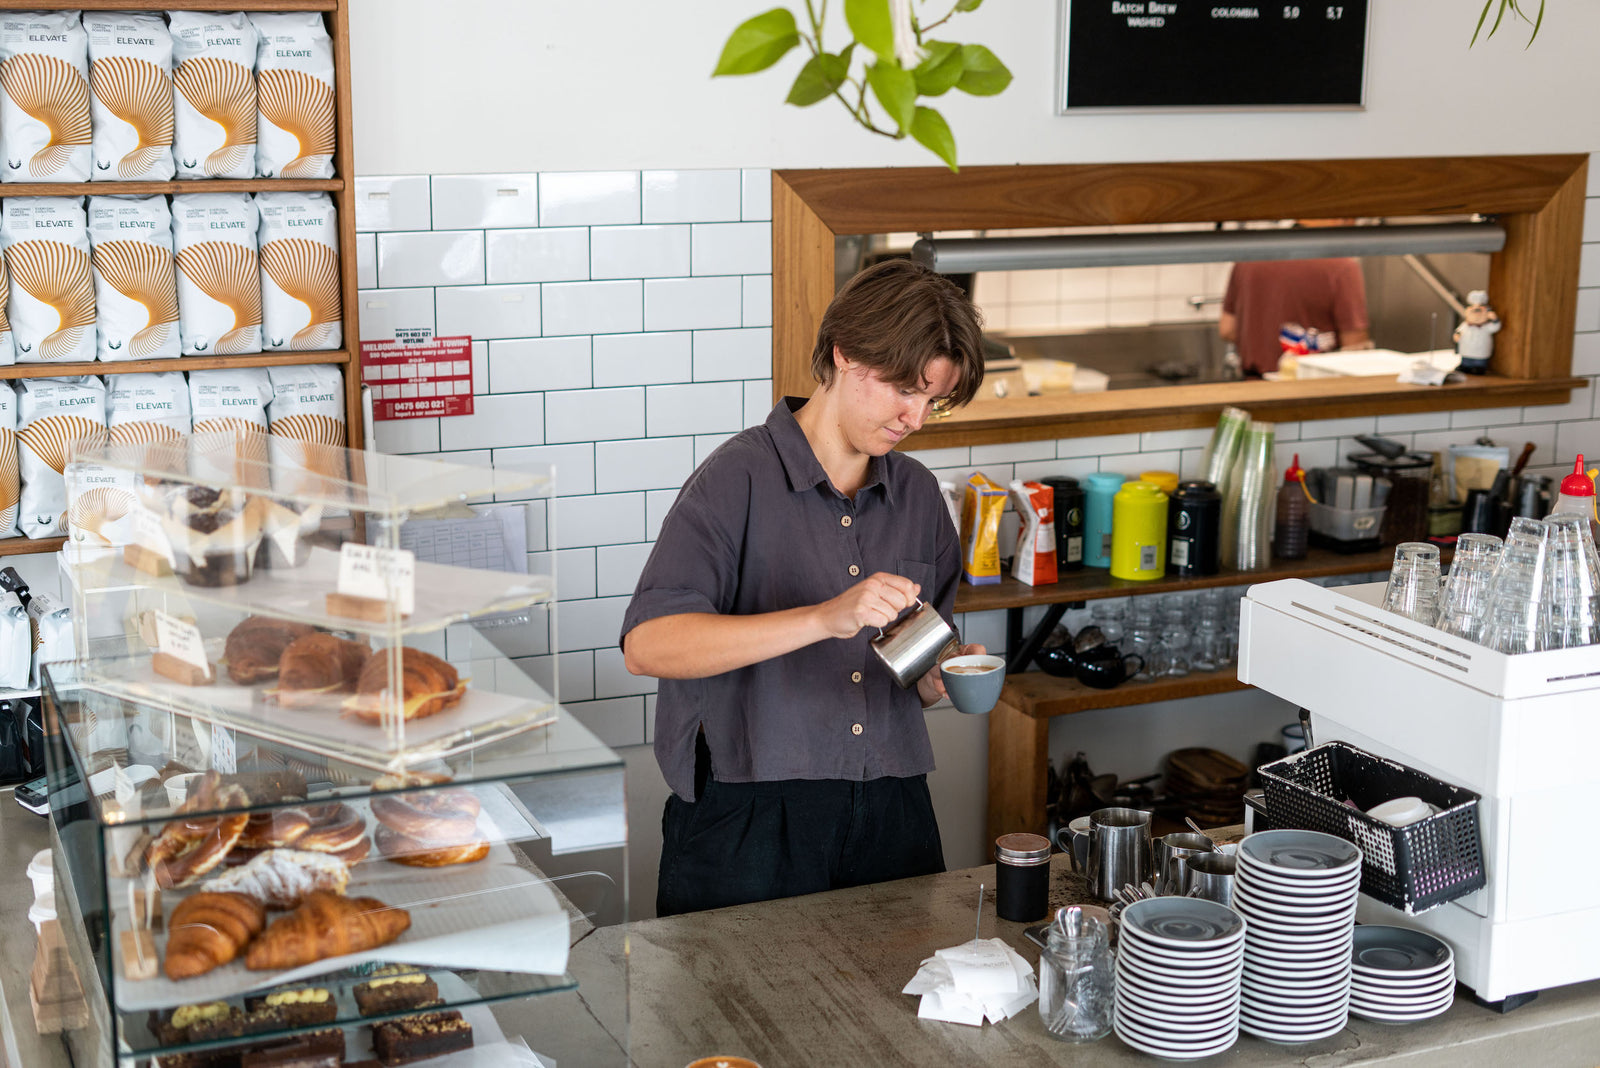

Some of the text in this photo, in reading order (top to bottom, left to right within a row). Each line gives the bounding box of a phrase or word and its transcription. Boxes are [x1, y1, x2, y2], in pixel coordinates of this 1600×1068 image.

[1211, 7, 1260, 19] COLOMBIA
[1127, 16, 1165, 28] WASHED
[29, 34, 67, 42] ELEVATE
[116, 37, 155, 46] ELEVATE
[206, 38, 241, 47] ELEVATE
[35, 220, 73, 228] ELEVATE
[119, 220, 156, 229] ELEVATE
[210, 221, 246, 229] ELEVATE
[287, 218, 323, 227] ELEVATE
[443, 339, 469, 348] TOWING
[59, 396, 96, 407] ELEVATE
[222, 398, 258, 406] ELEVATE
[300, 393, 335, 402] ELEVATE
[136, 401, 173, 410] ELEVATE
[395, 402, 414, 410] 0475
[431, 400, 445, 408] 021
